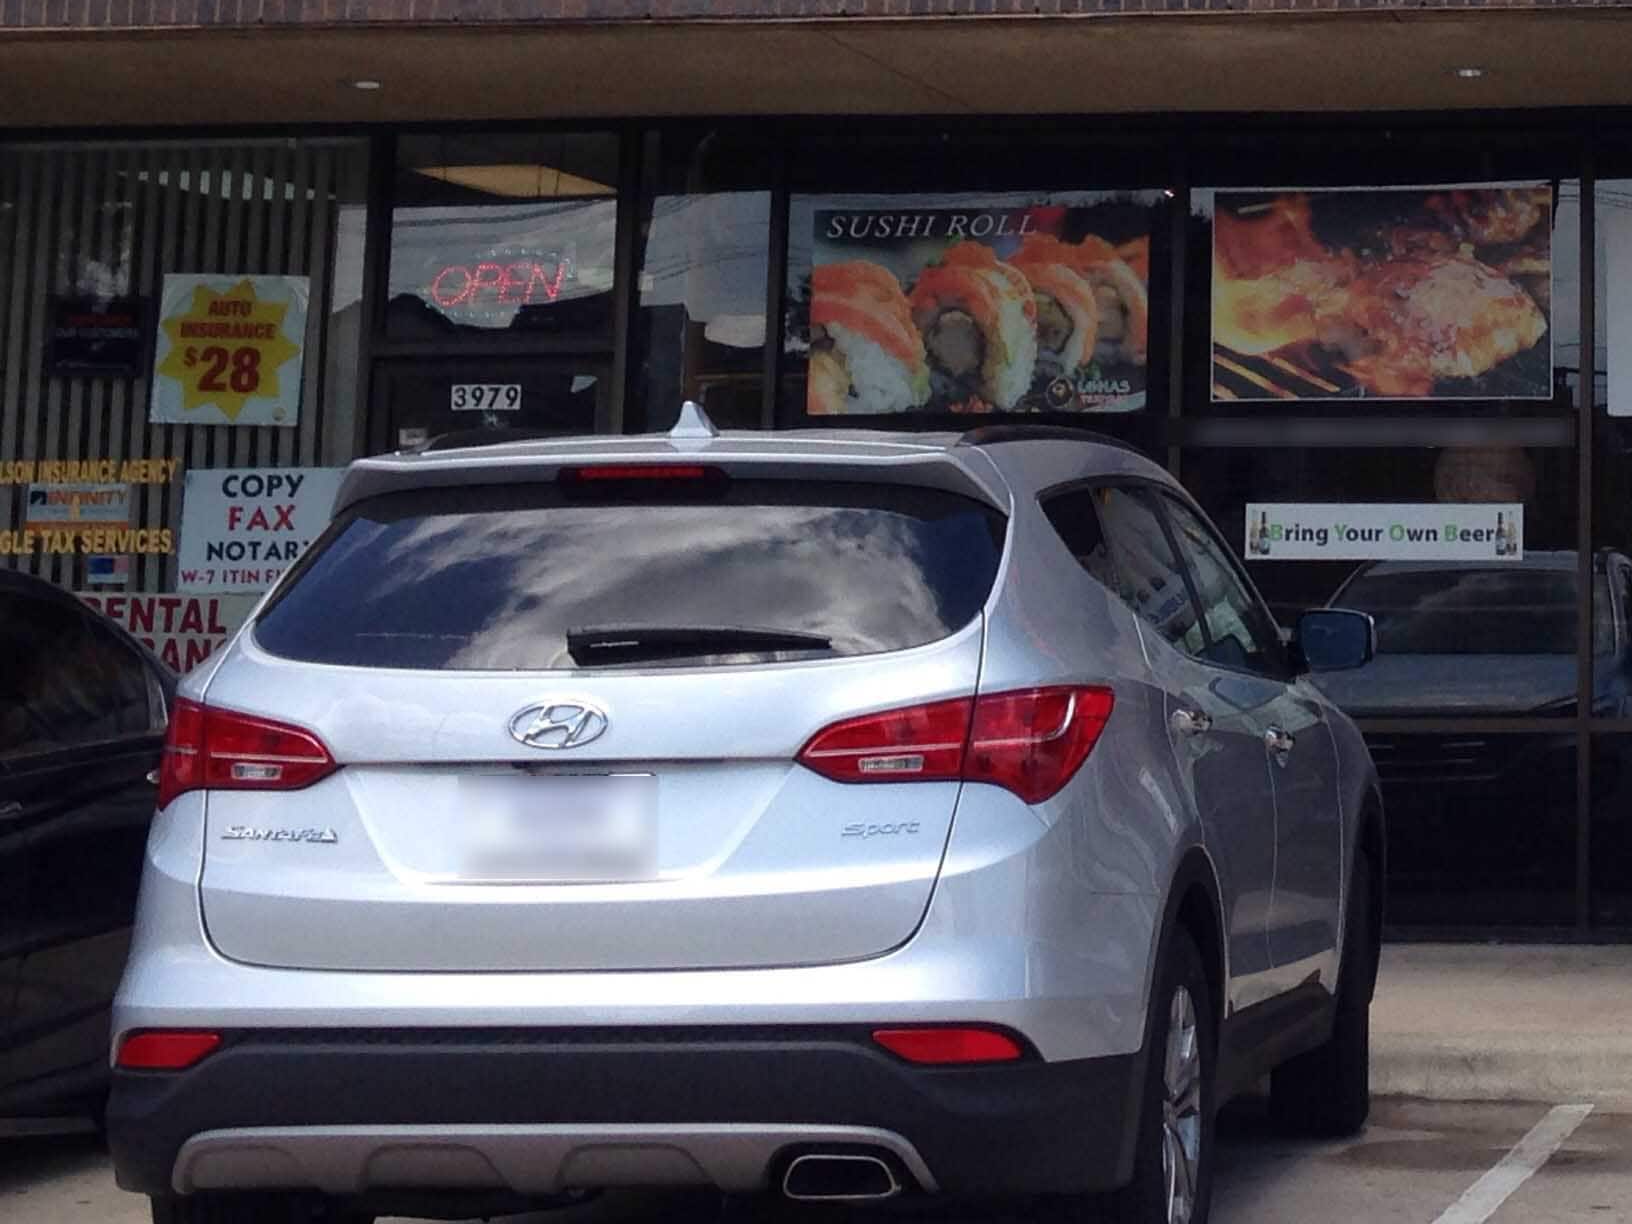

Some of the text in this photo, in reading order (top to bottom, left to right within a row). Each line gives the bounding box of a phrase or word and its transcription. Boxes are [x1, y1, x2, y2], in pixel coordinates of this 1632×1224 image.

[826, 213, 1038, 238] SUSHI ROLL
[431, 259, 566, 307] OPEN
[207, 300, 253, 317] AUTO
[179, 323, 276, 340] INSURANCE
[183, 346, 262, 393] $28
[453, 387, 519, 408] 3979
[39, 459, 117, 485] INSURANCE
[121, 457, 178, 484] AGENCY
[222, 474, 304, 499] COPY
[227, 504, 296, 531] FAX
[42, 530, 75, 554] TAX
[1270, 524, 1495, 544] Bring Your Own Beer
[206, 540, 310, 562] NOTAR
[222, 569, 261, 585] ITIN
[840, 817, 921, 840] Sport
